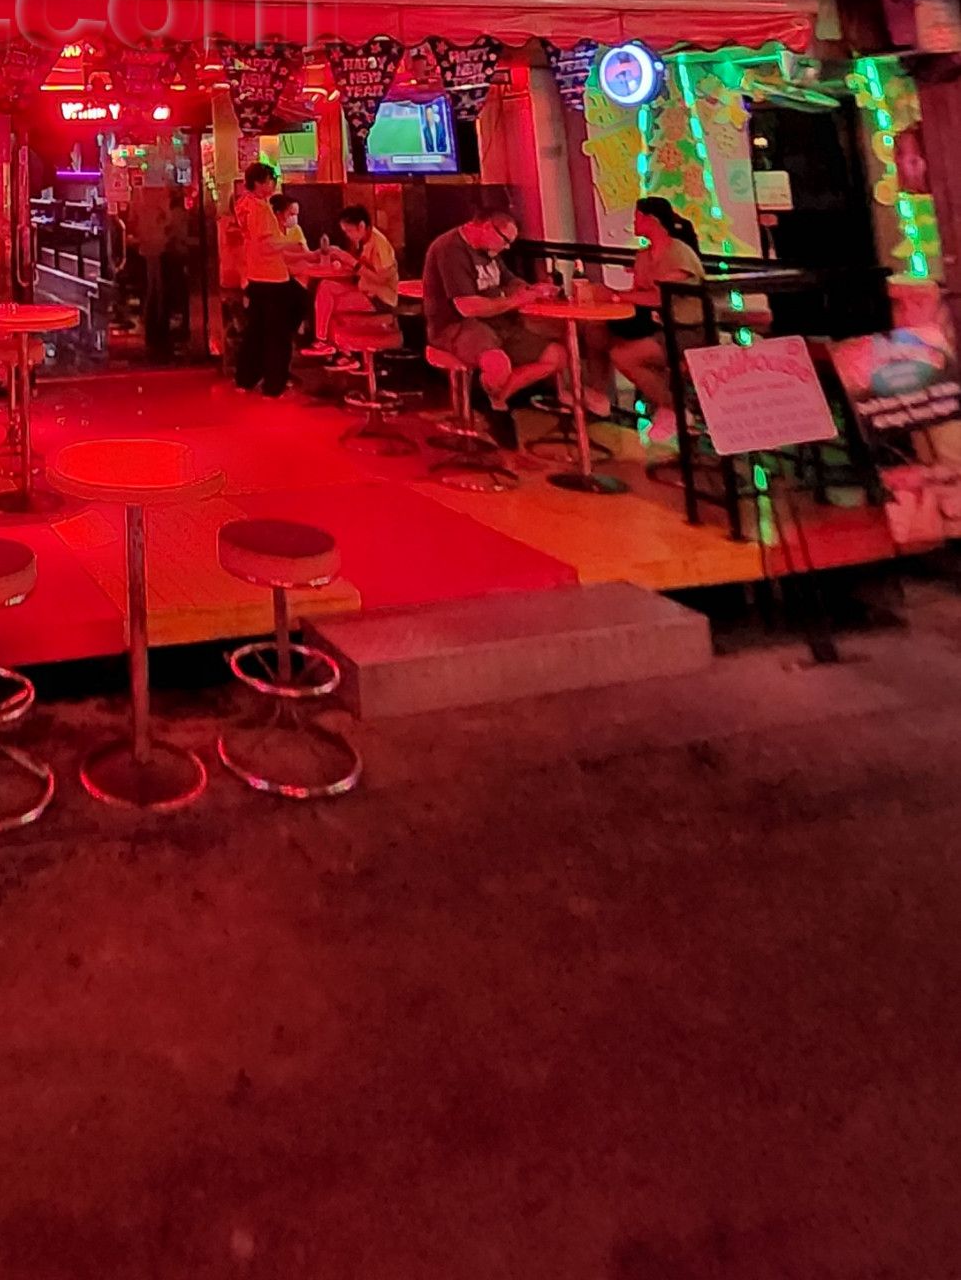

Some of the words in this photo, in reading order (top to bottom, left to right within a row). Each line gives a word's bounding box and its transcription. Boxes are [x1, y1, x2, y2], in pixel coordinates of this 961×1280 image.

[236, 57, 280, 72] APPY
[343, 56, 386, 70] HAPY
[349, 71, 382, 85] NEW
